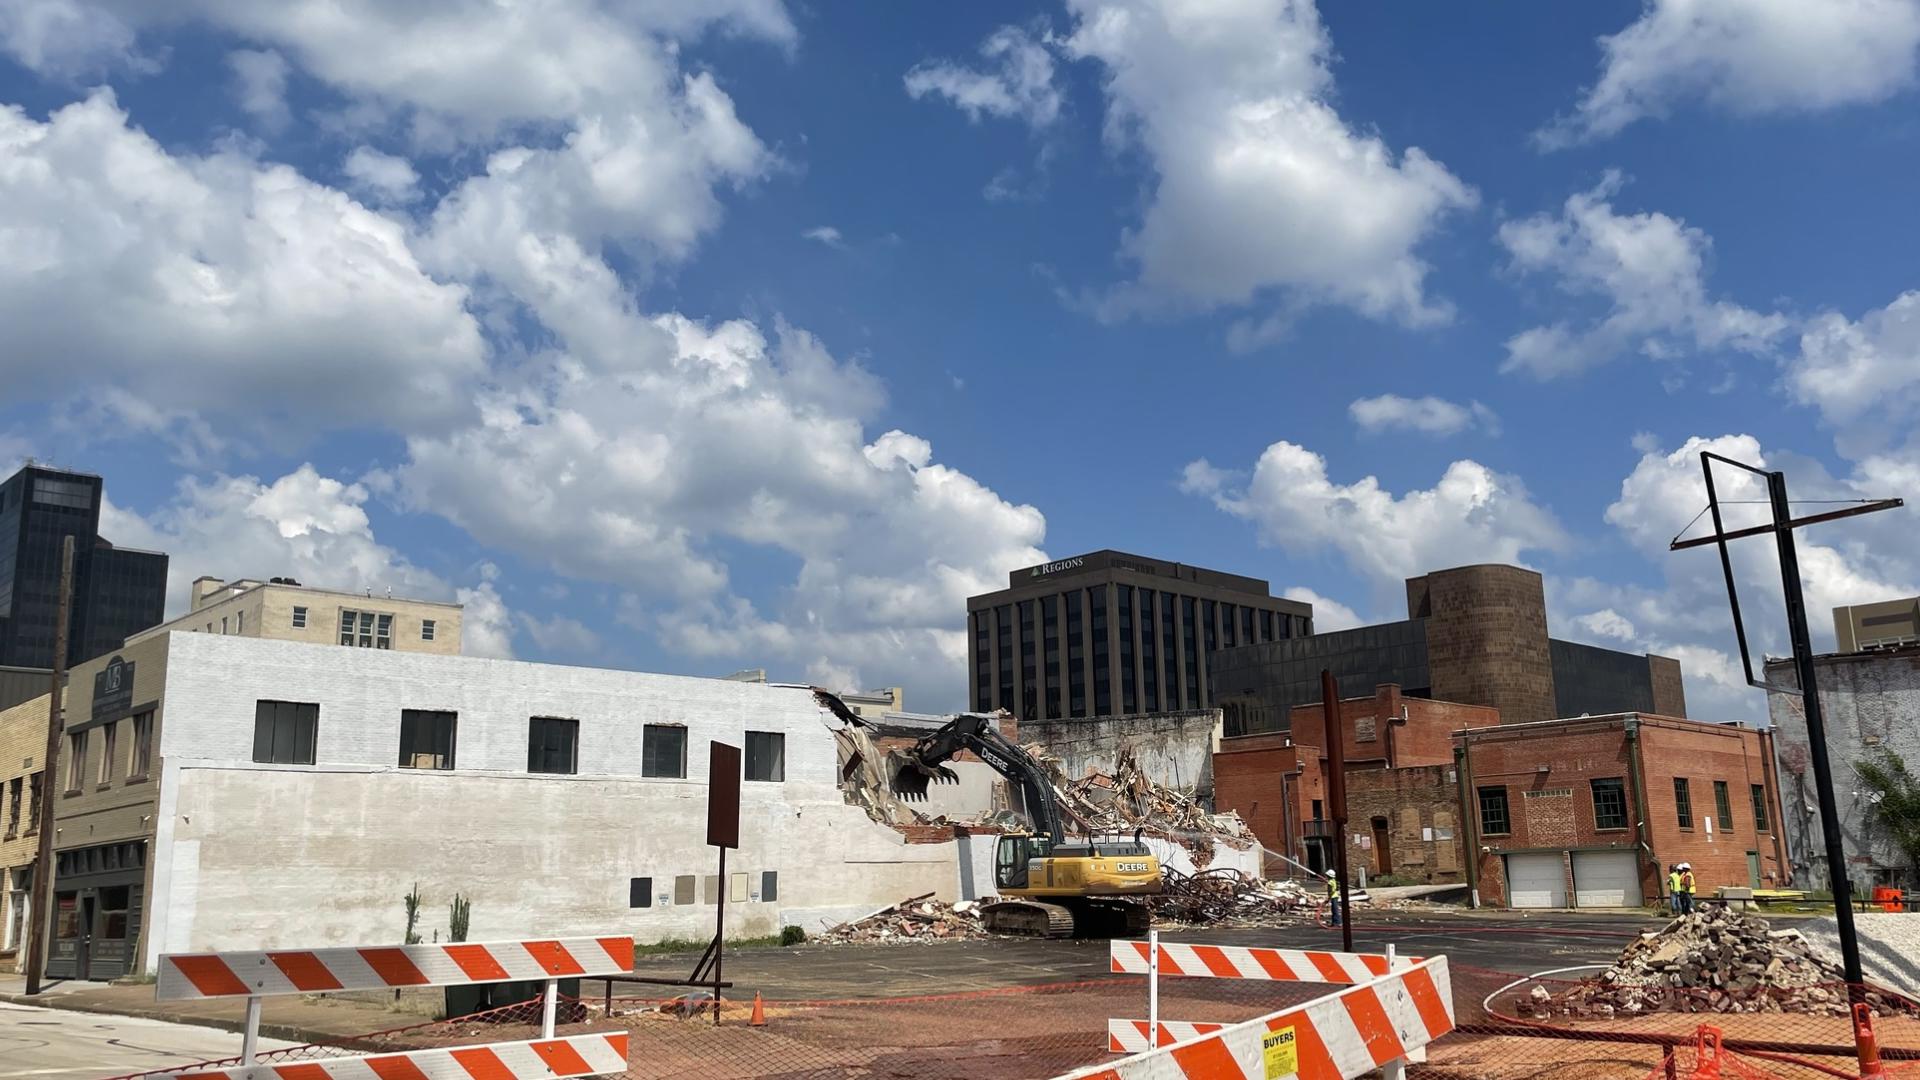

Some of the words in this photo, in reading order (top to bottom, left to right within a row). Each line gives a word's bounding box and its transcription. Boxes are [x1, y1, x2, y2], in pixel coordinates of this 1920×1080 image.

[1042, 557, 1084, 574] REGIONS
[981, 746, 1009, 772] DEERE
[1117, 862, 1148, 872] DEERE
[1263, 1031, 1294, 1049] BUYERS
